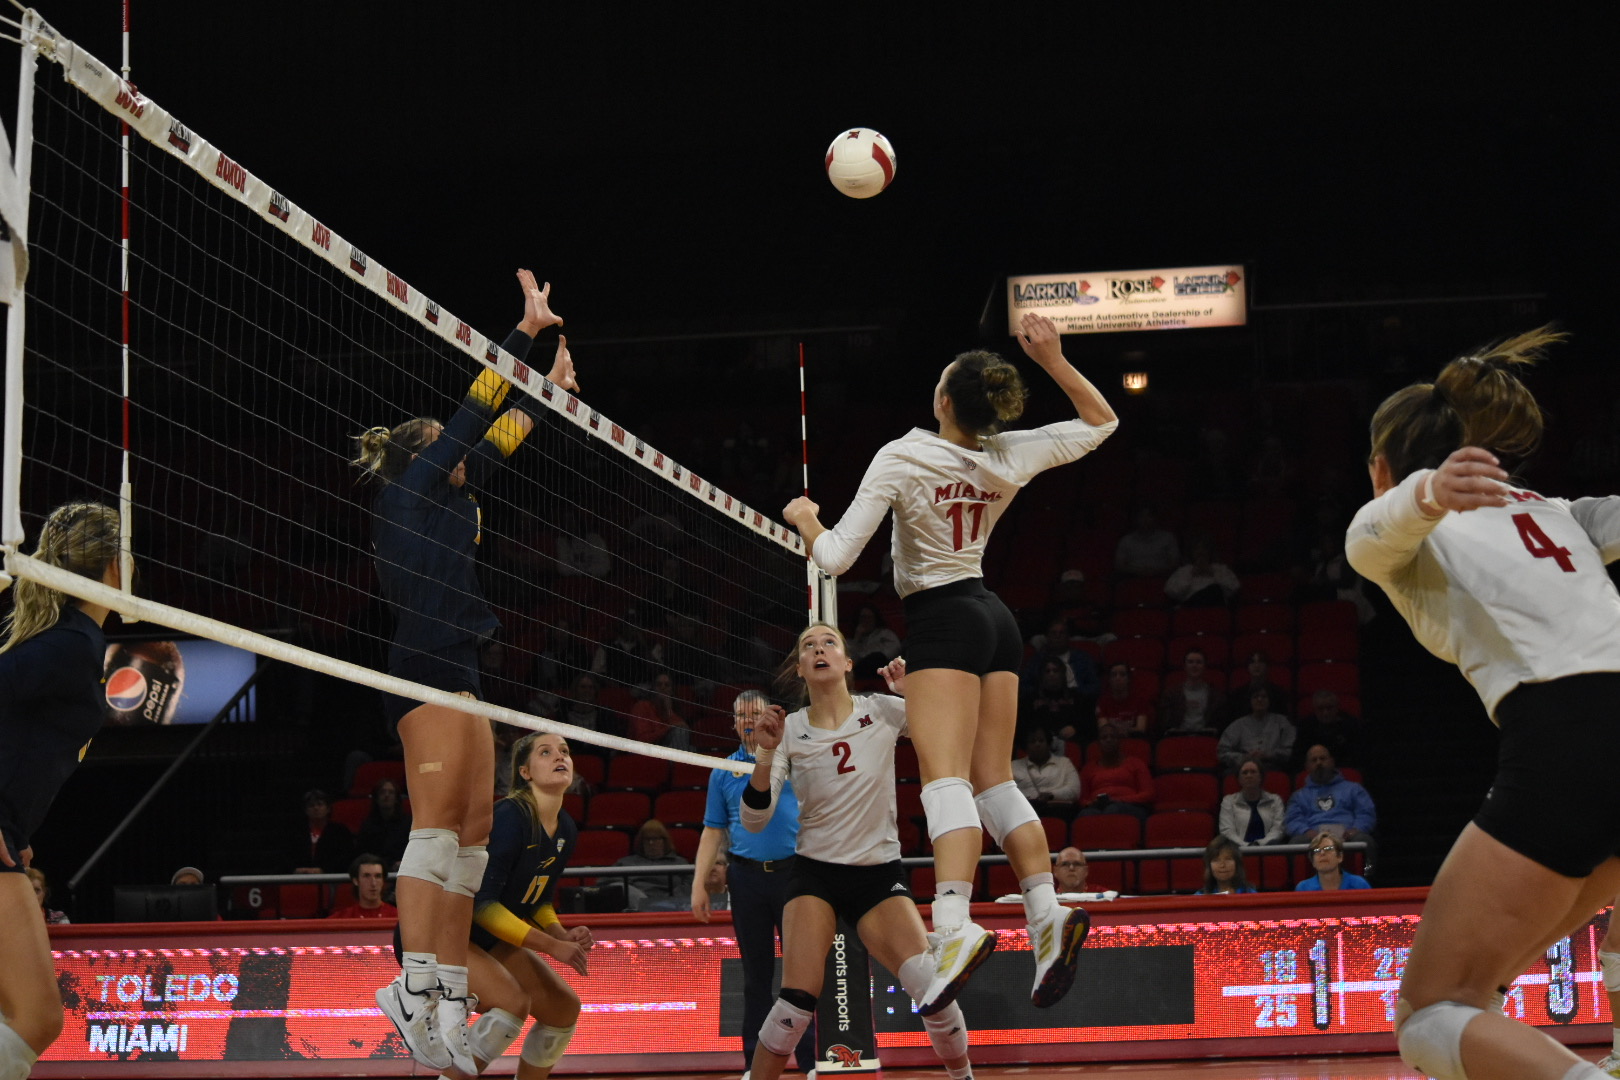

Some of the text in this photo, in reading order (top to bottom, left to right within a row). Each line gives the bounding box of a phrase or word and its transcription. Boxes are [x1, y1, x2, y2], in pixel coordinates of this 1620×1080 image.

[312, 219, 331, 252] LOVE
[1014, 282, 1077, 302] LARKIN
[1105, 278, 1154, 300] ROSE
[1067, 318, 1187, 331] Miami University Athletics
[1096, 311, 1149, 321] Automotive
[1152, 308, 1201, 318] Dealership
[1203, 307, 1214, 316] of
[1511, 513, 1577, 573] 4
[143, 679, 162, 721] pepsi
[857, 714, 873, 728] M
[832, 741, 856, 775] 2
[248, 888, 262, 908] 6
[521, 875, 550, 904] 17
[95, 973, 239, 1003] TOLEDO
[833, 933, 850, 1031] sports imports
[1254, 994, 1298, 1027] 25
[88, 1024, 188, 1053] MIAMI
